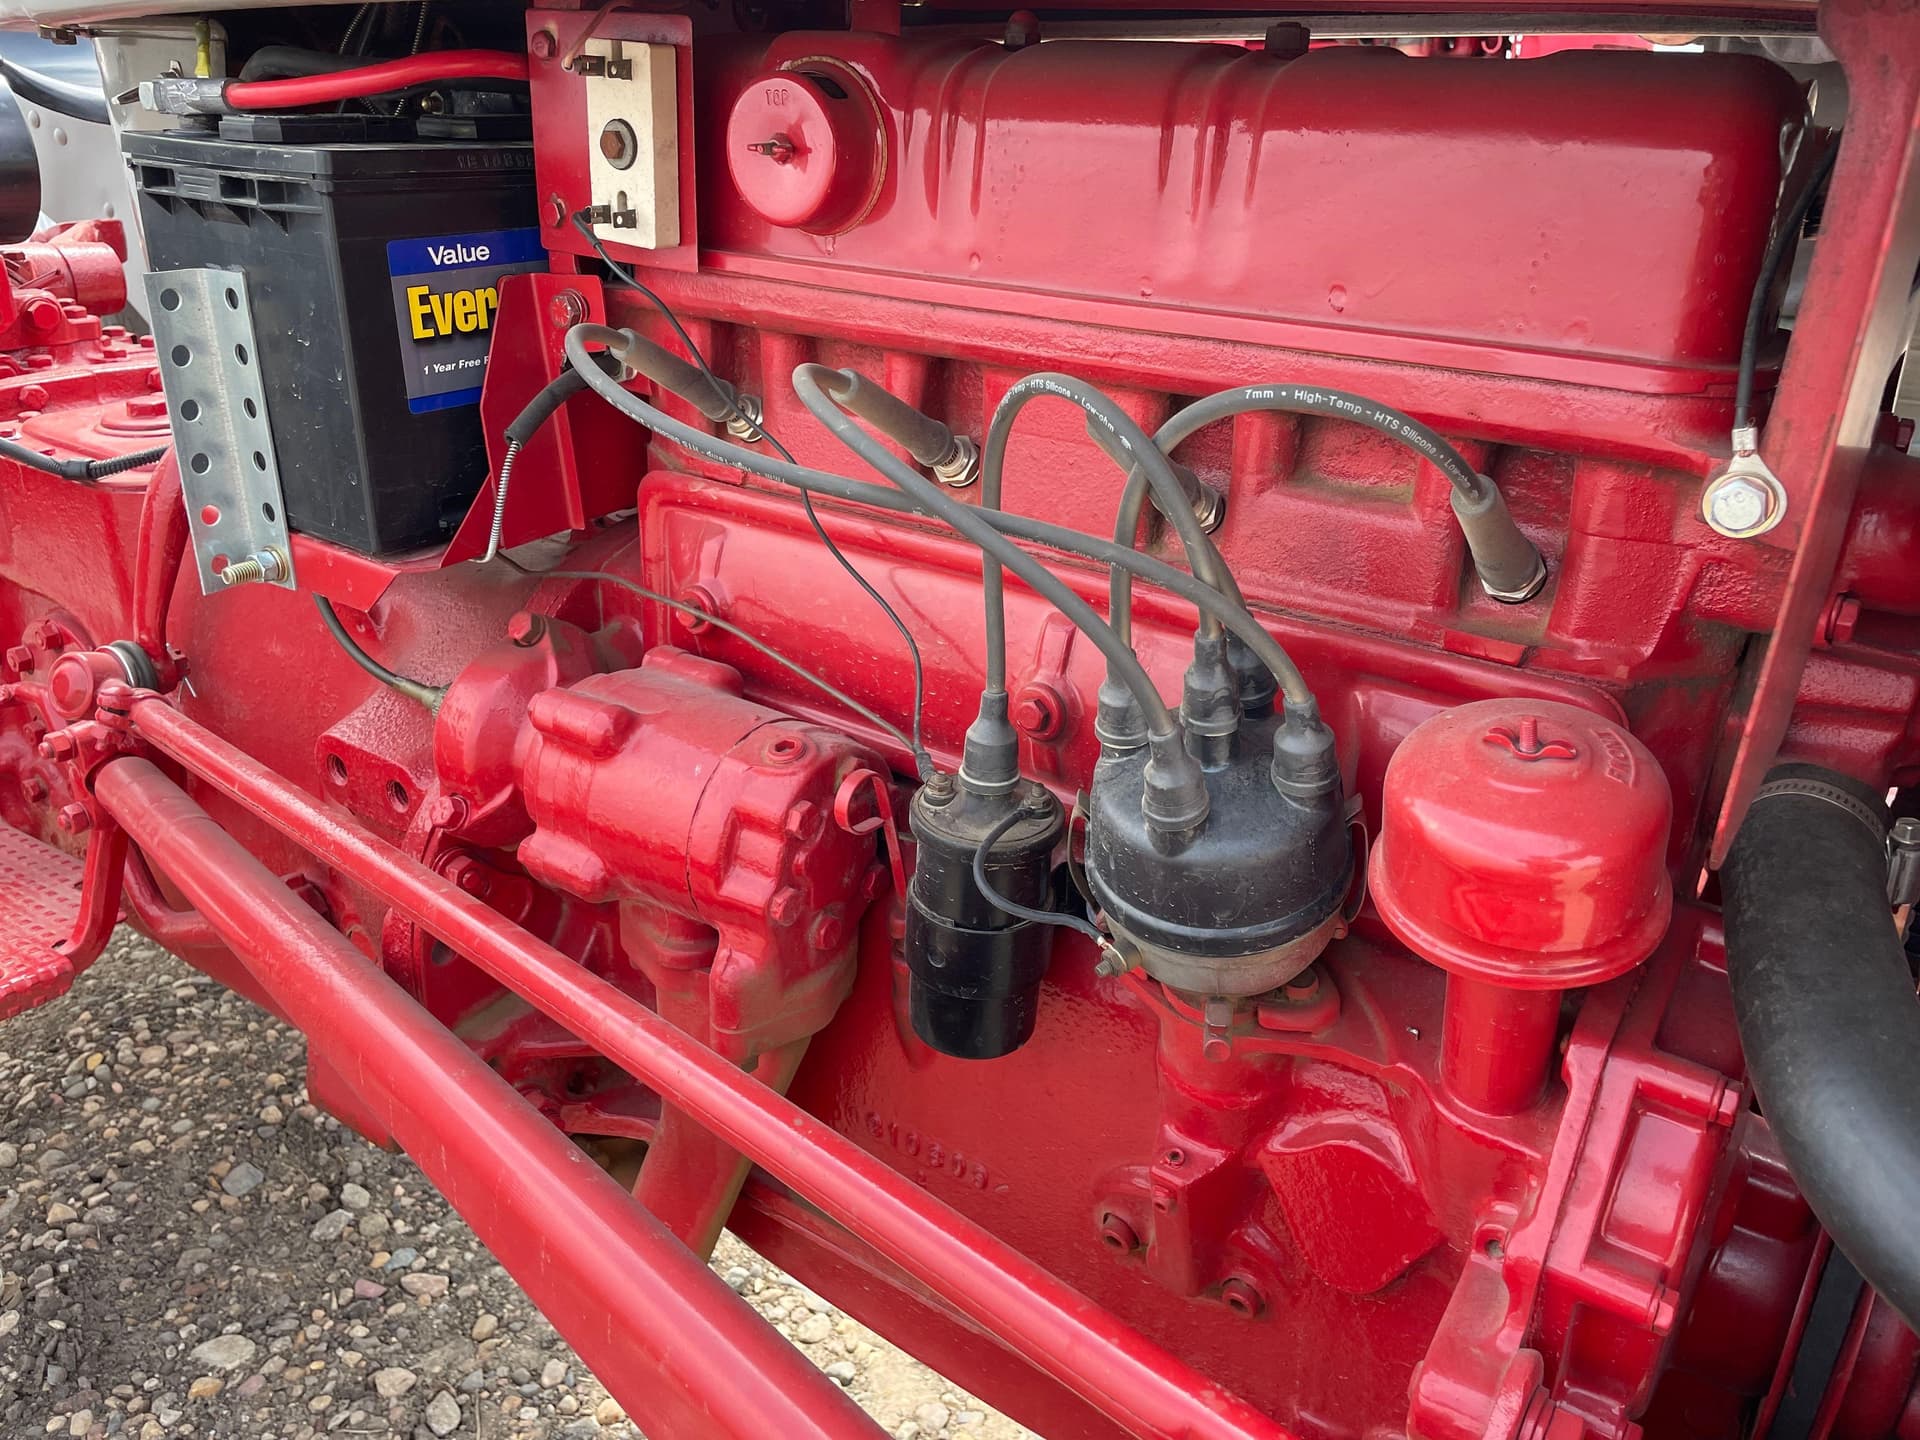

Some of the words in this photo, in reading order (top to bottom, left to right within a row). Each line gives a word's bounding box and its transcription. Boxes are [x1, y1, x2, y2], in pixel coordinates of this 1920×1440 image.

[427, 243, 490, 266] Value
[406, 285, 498, 341] Ever
[424, 366, 430, 375] 1
[433, 362, 456, 374] Year
[458, 358, 481, 370] Free
[1244, 389, 1274, 400] 7mm
[1294, 389, 1363, 415] High-Temp
[1373, 410, 1400, 430] HTS
